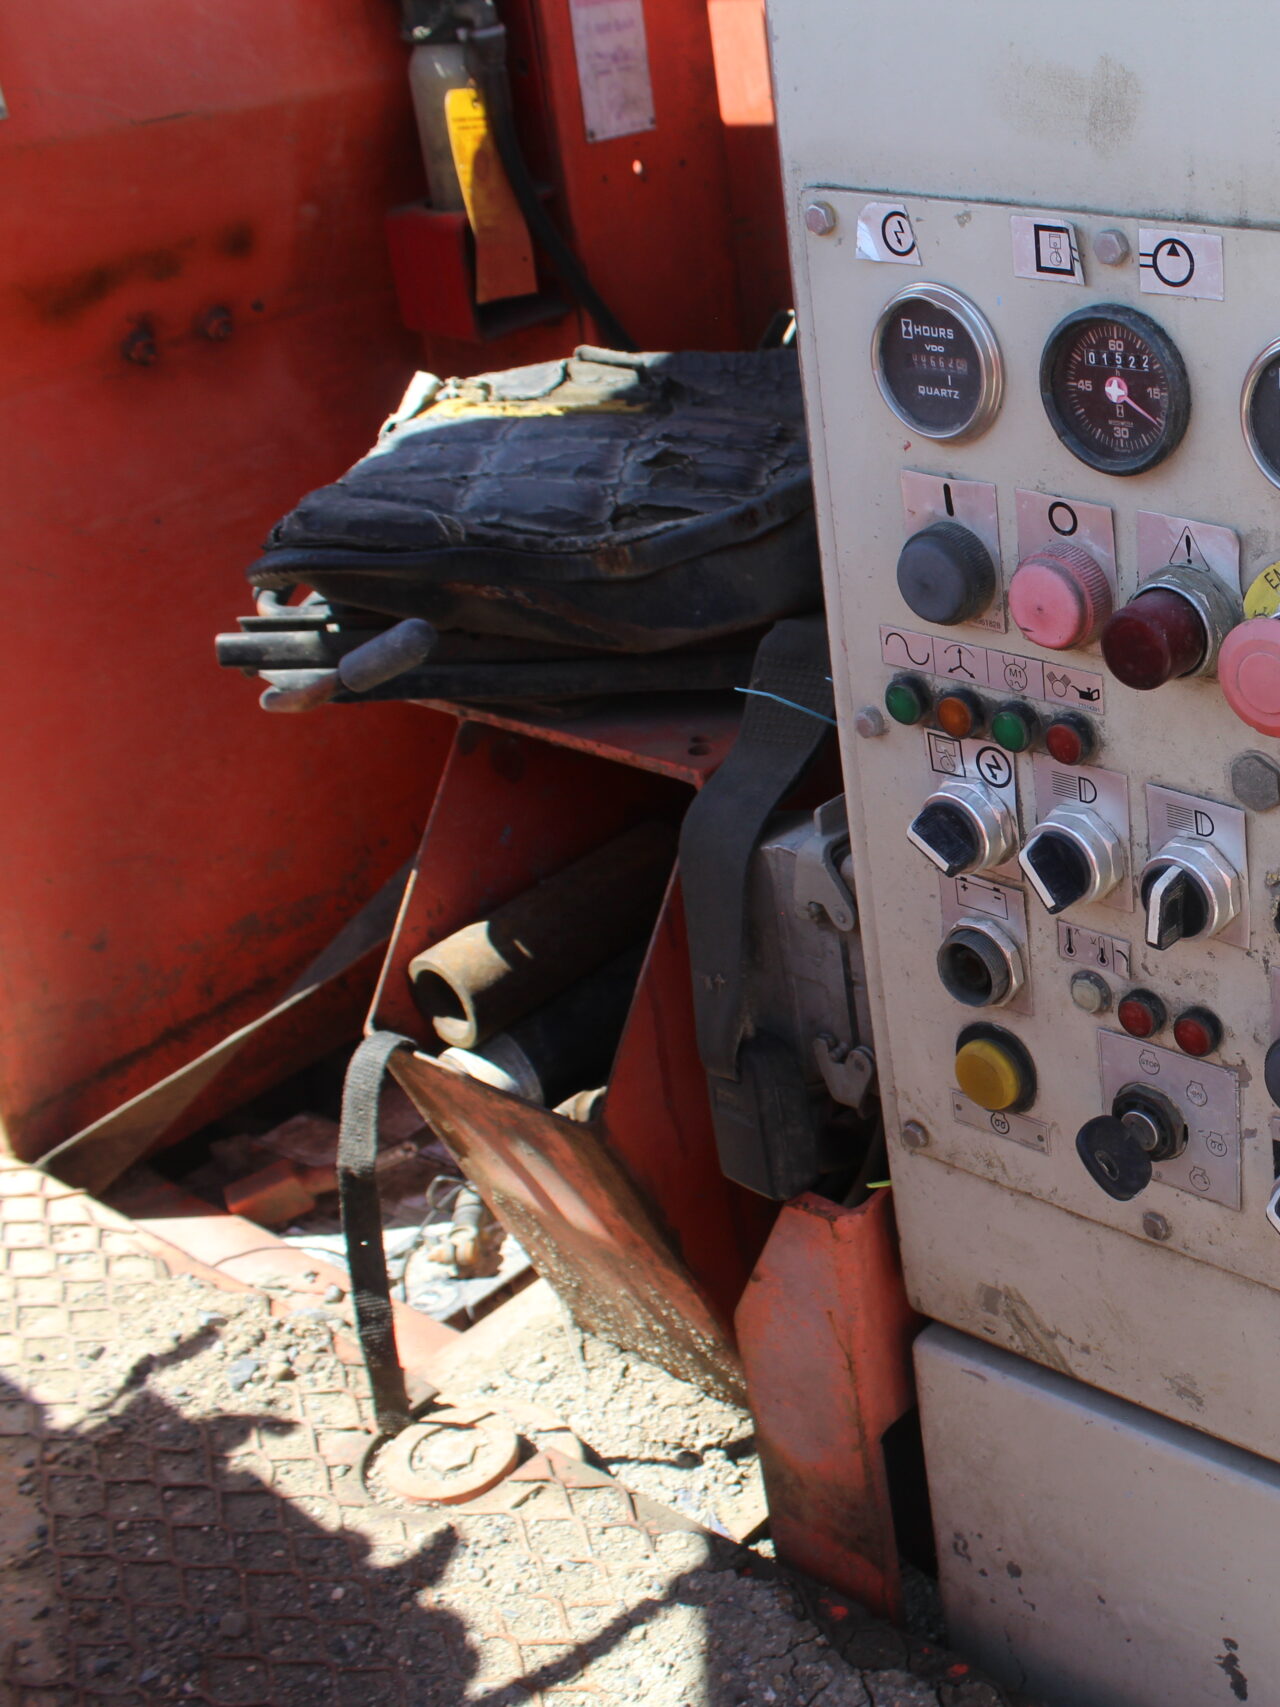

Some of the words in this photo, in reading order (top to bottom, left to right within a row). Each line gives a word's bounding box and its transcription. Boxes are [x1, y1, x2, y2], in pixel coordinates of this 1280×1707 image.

[913, 324, 954, 340] HOURS
[924, 343, 945, 353] VDO
[1108, 340, 1124, 351] 60
[1088, 352, 1149, 369] 01522
[1077, 380, 1093, 392] 45
[918, 385, 960, 400] QUARTZ
[1146, 387, 1161, 400] 15
[1113, 427, 1130, 439] 30
